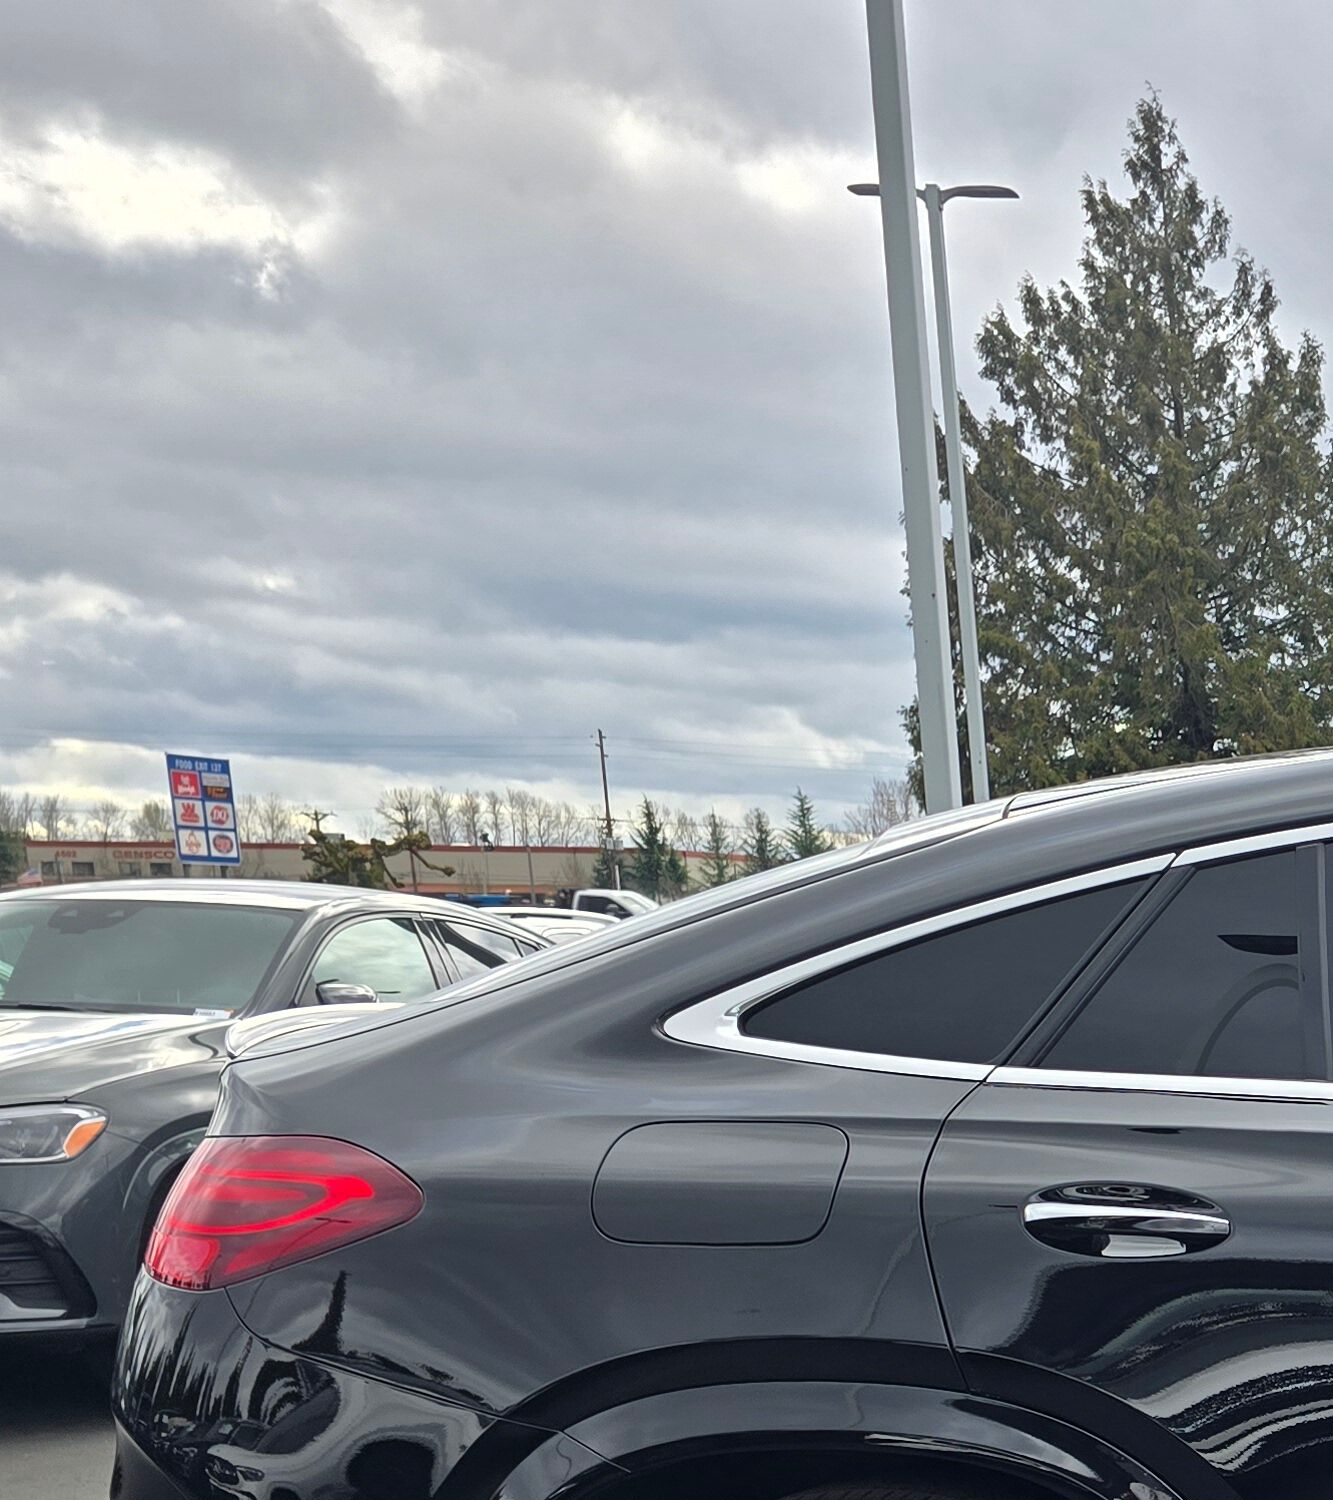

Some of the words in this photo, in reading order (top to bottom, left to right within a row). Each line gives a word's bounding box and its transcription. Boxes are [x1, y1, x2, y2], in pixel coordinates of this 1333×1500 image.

[175, 759, 193, 770] FOOD
[195, 760, 208, 772] EXIT
[112, 850, 176, 860] GENSCO
